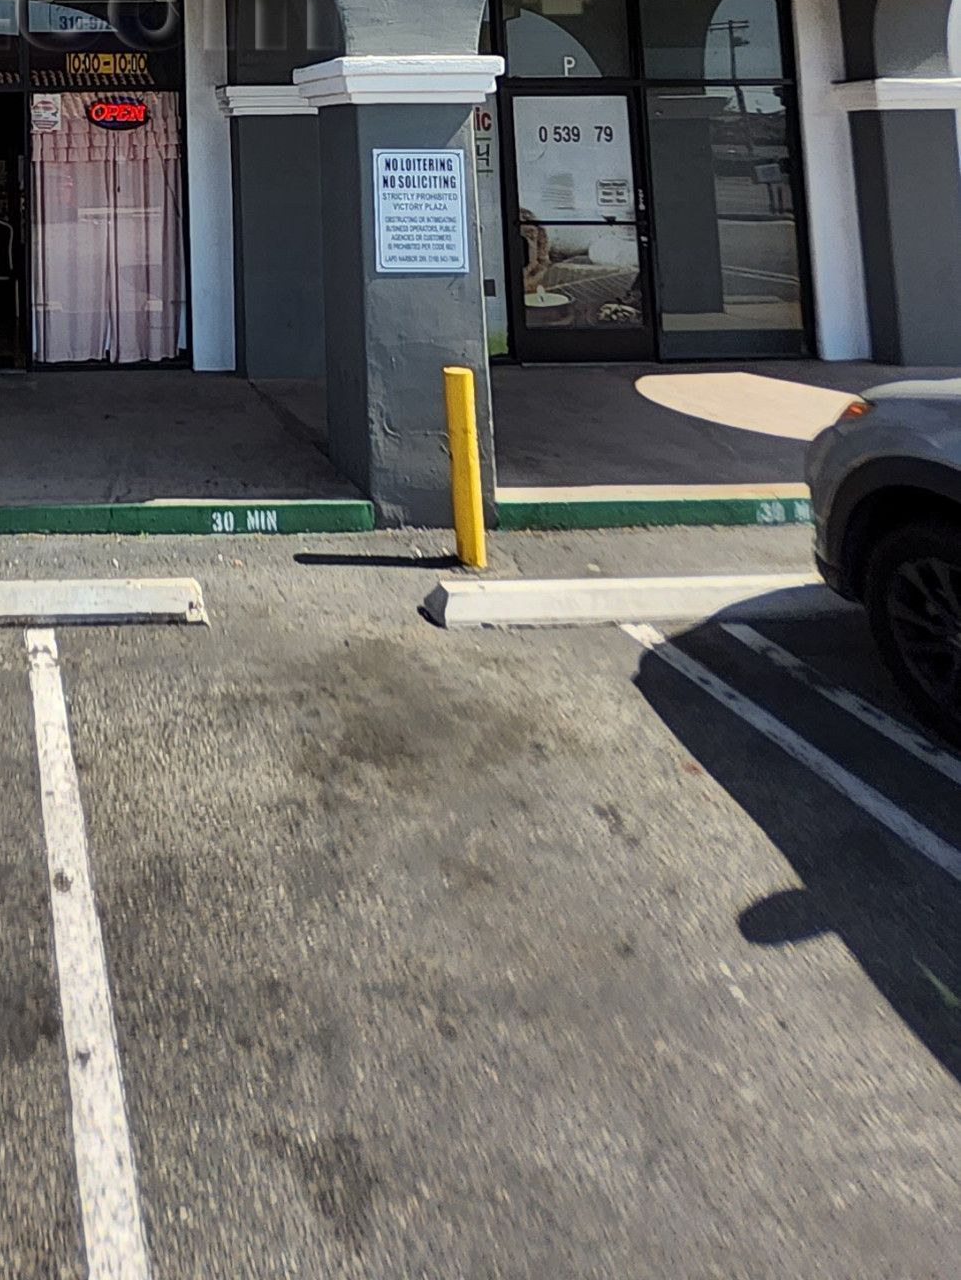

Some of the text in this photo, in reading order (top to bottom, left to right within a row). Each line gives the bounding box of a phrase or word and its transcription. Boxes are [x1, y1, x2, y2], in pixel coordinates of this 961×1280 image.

[564, 55, 576, 77] P
[91, 103, 146, 122] OPEN
[553, 125, 581, 143] 539
[594, 125, 614, 143] 79
[384, 158, 453, 172] NO LOITERING
[382, 175, 457, 189] NO SOLICITING
[382, 192, 416, 201] STRICTLY
[392, 202, 448, 210] VICTORY PLAZA
[211, 509, 278, 532] 30 MIN
